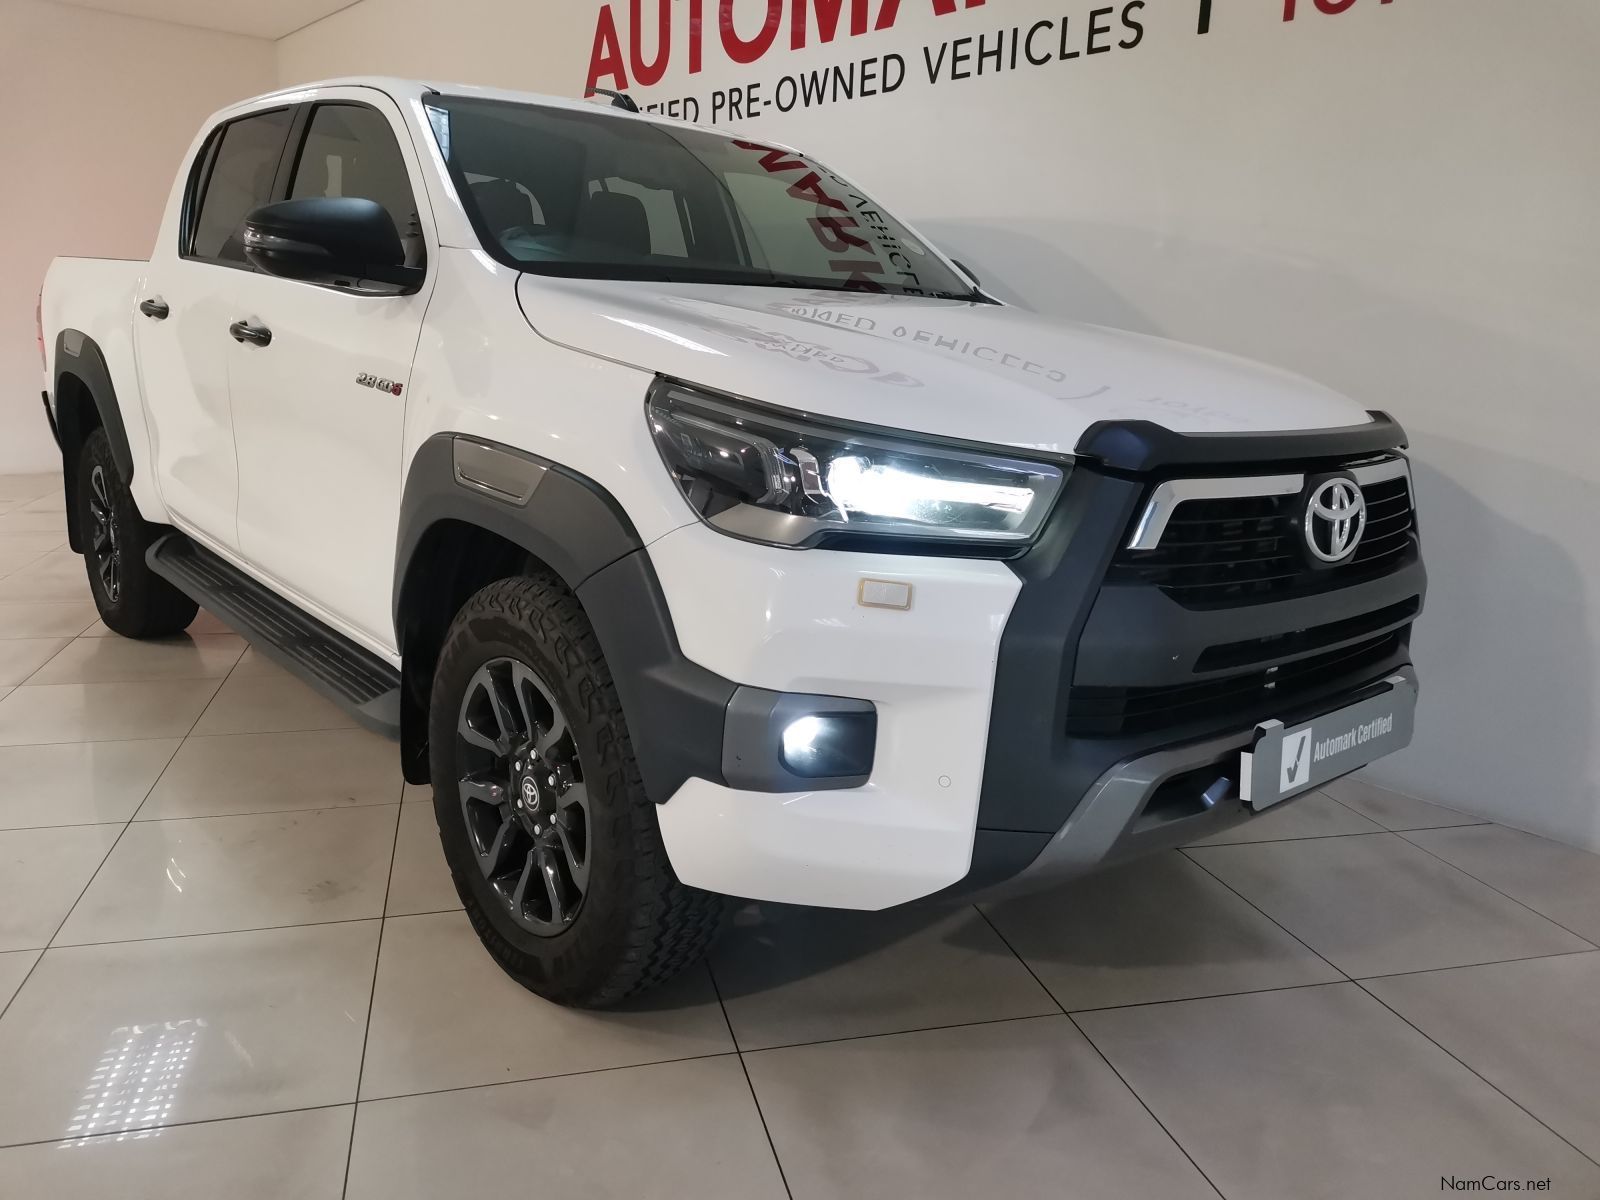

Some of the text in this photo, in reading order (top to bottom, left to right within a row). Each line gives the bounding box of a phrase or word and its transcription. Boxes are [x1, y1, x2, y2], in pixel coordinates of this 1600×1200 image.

[583, 0, 986, 98] AUTO
[711, 0, 1145, 125] PRE-OWNED VEHICLES
[1313, 713, 1392, 763] Automark Certified
